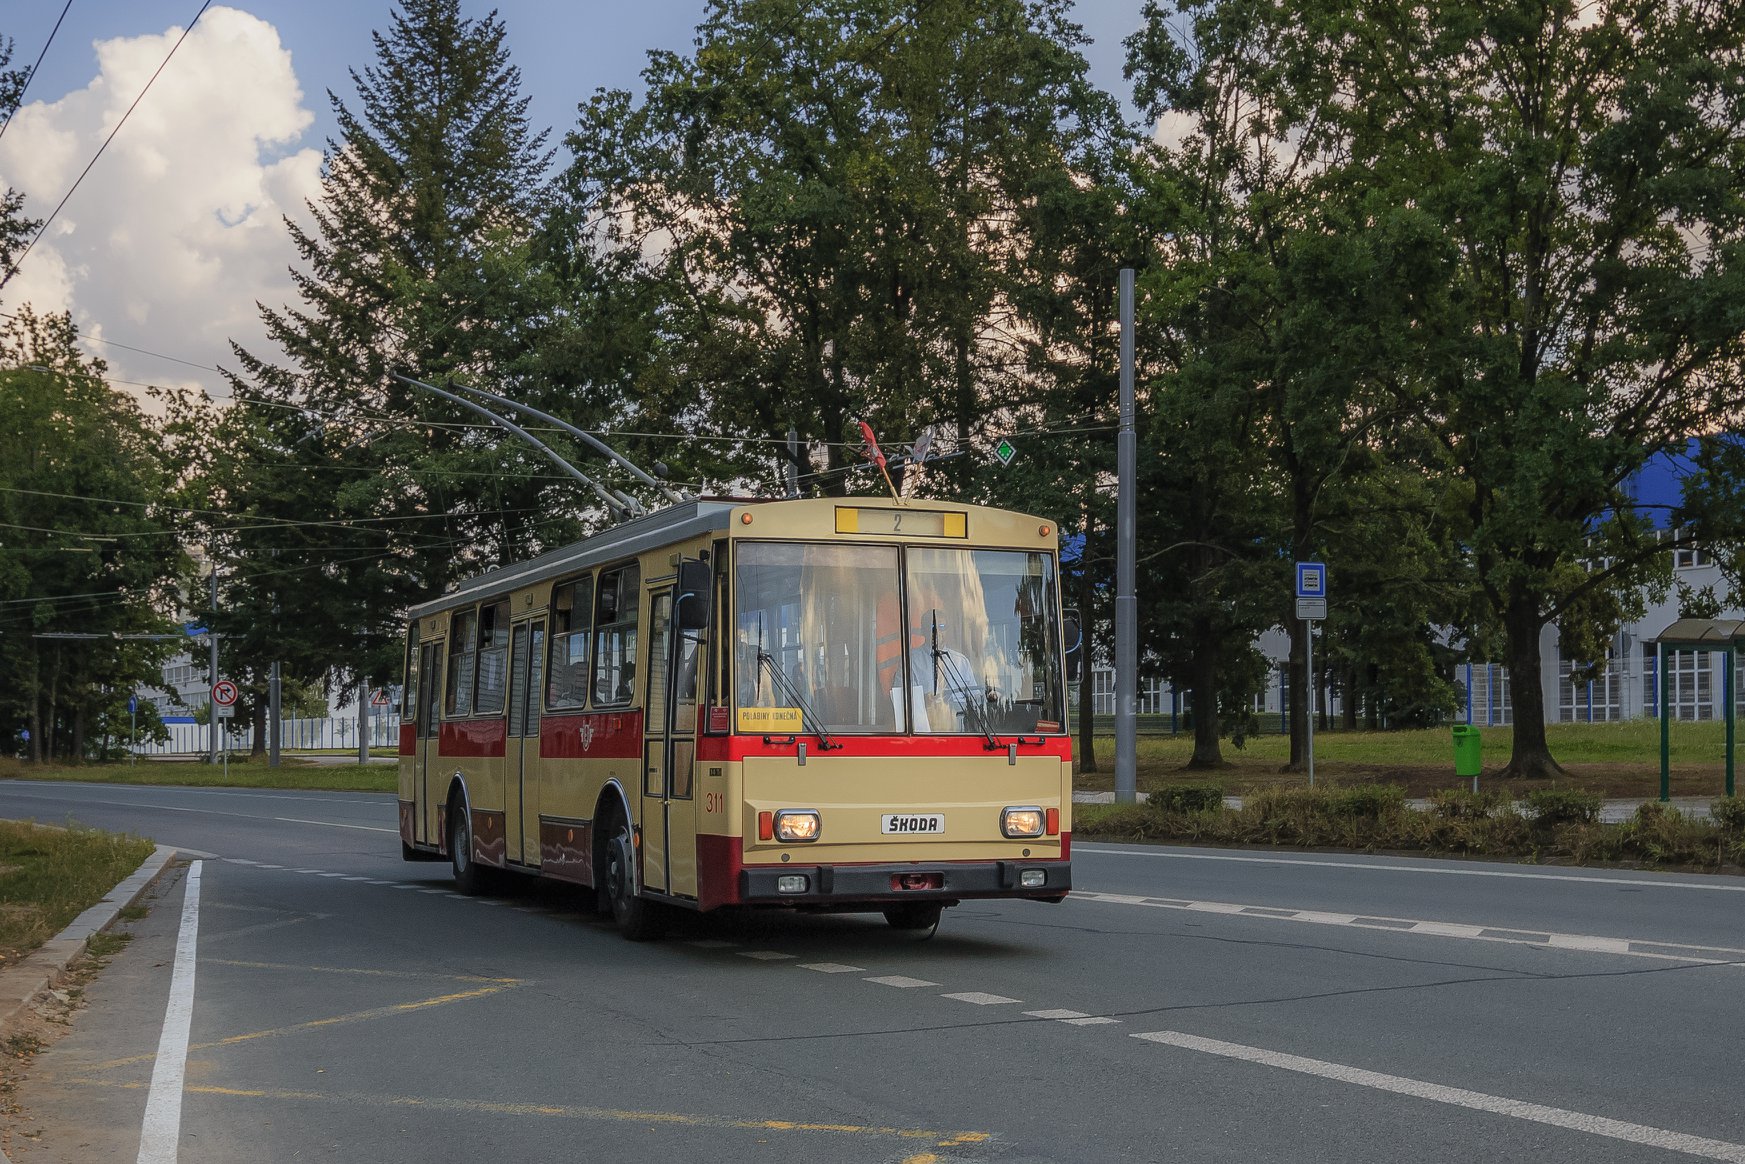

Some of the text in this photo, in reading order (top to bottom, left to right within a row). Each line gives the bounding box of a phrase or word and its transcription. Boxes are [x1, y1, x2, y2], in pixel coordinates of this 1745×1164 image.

[893, 513, 902, 532] 2
[706, 792, 723, 813] 311
[889, 816, 938, 831] ŠKODA
